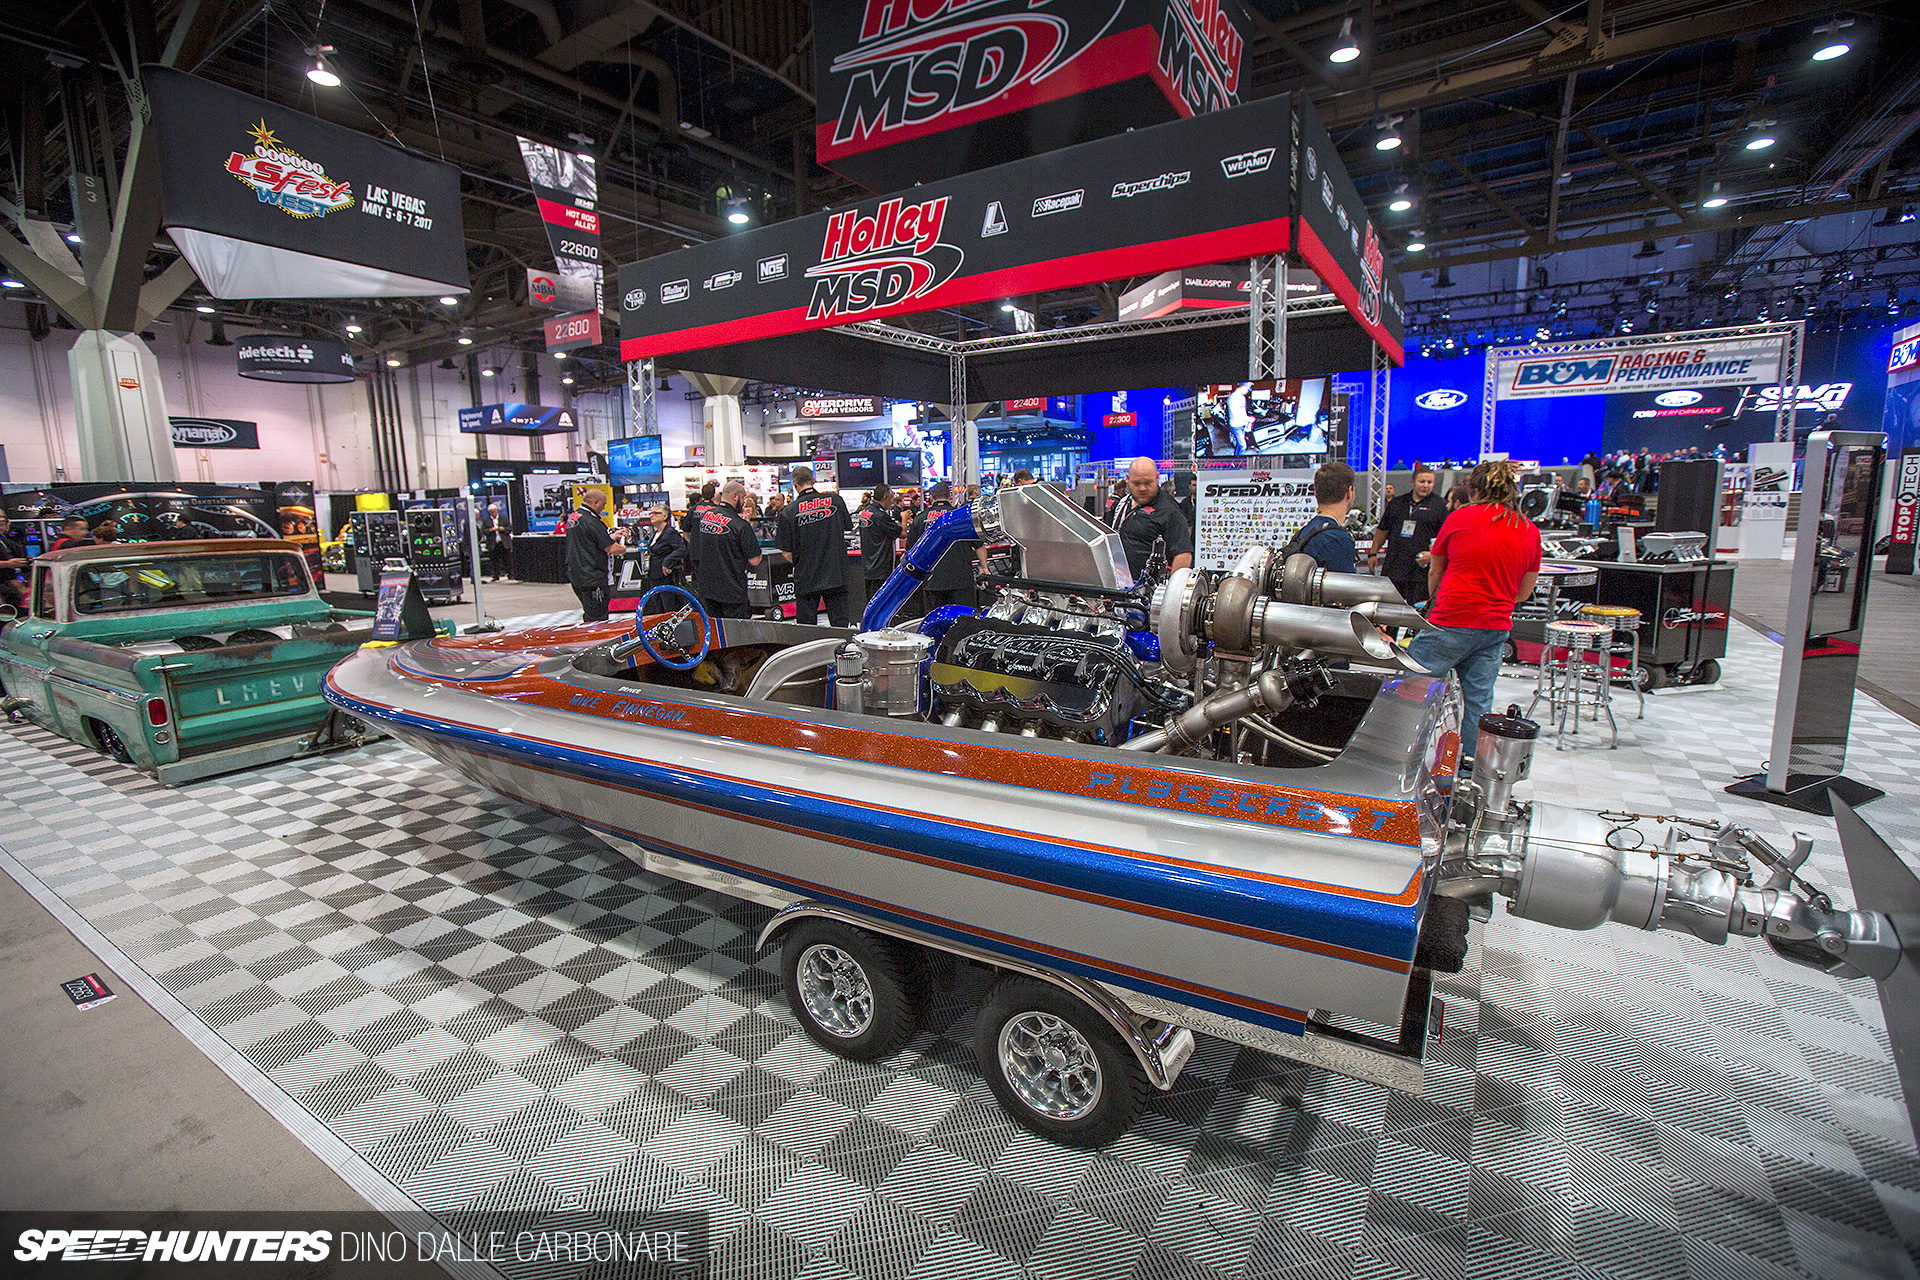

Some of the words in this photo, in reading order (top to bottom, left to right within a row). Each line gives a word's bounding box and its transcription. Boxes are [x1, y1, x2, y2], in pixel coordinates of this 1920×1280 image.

[832, 27, 1028, 146] MSD
[1227, 156, 1267, 172] WEIAND
[1112, 170, 1191, 198] Superchips
[256, 186, 331, 218] WEST
[366, 184, 389, 205] LAS
[391, 191, 426, 215] VEGAS
[361, 200, 384, 217] MAY
[414, 215, 433, 230] 2017
[565, 208, 580, 219] HOT
[580, 212, 596, 223] ROD
[574, 219, 597, 231] ALLEY
[821, 196, 949, 262] Holley
[560, 240, 598, 260] 22600
[531, 282, 556, 296] MBM
[1185, 278, 1231, 288] DIABLOSPORT
[806, 263, 915, 320] MSD
[555, 319, 589, 340] 22600
[239, 346, 296, 360] ridetech
[1620, 351, 1687, 369] RACING
[1692, 350, 1706, 364] &
[1518, 359, 1613, 386] B&M
[1615, 359, 1753, 382] PERFORMANCE
[804, 398, 873, 408] OVERDRIVE
[840, 406, 874, 414] VENDORS
[1013, 397, 1039, 408] 22400
[1109, 415, 1131, 424] 22300
[1657, 406, 1724, 417] PERFORMANCE
[171, 426, 226, 441] ynamat
[799, 497, 832, 513] Holley
[703, 511, 732, 526] Holley
[798, 509, 826, 527] MSD
[928, 510, 947, 519] Holl
[775, 583, 795, 595] VR
[568, 694, 602, 709] MIKE
[611, 700, 687, 722] FINNEGAN
